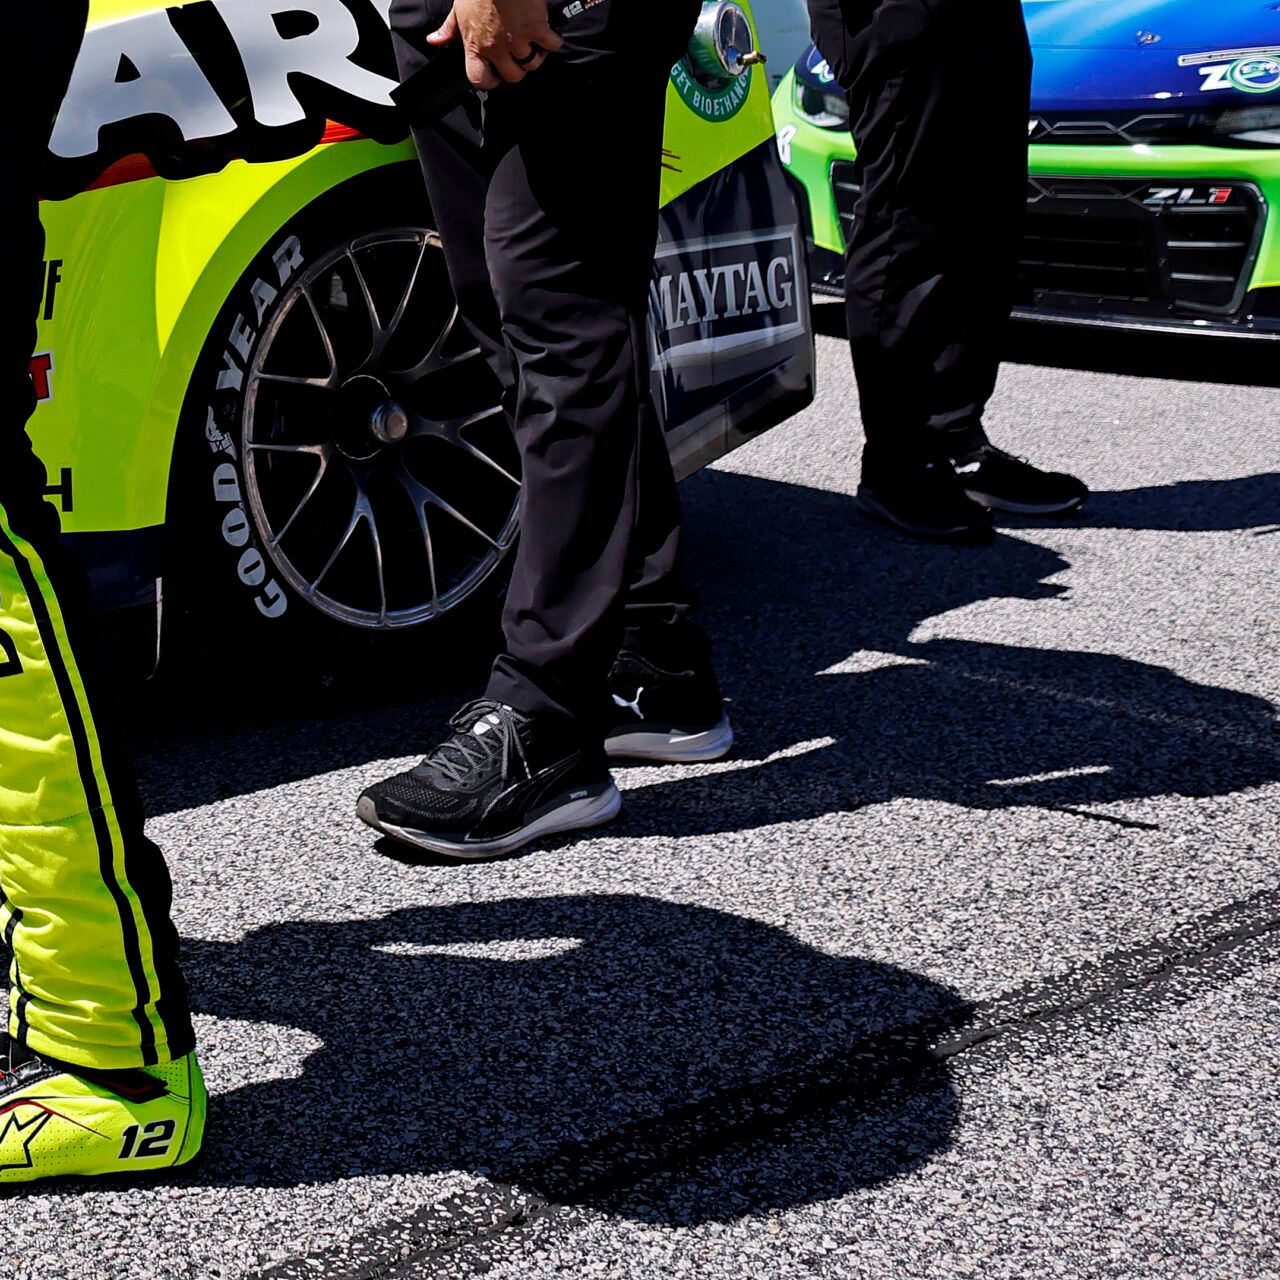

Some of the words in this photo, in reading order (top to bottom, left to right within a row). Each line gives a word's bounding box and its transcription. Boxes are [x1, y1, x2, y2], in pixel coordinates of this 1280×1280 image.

[562, 0, 584, 19] 12
[671, 64, 692, 94] GET
[1142, 186, 1233, 205] ZL1
[648, 256, 793, 331] MAYTAG
[117, 1119, 176, 1160] 12
